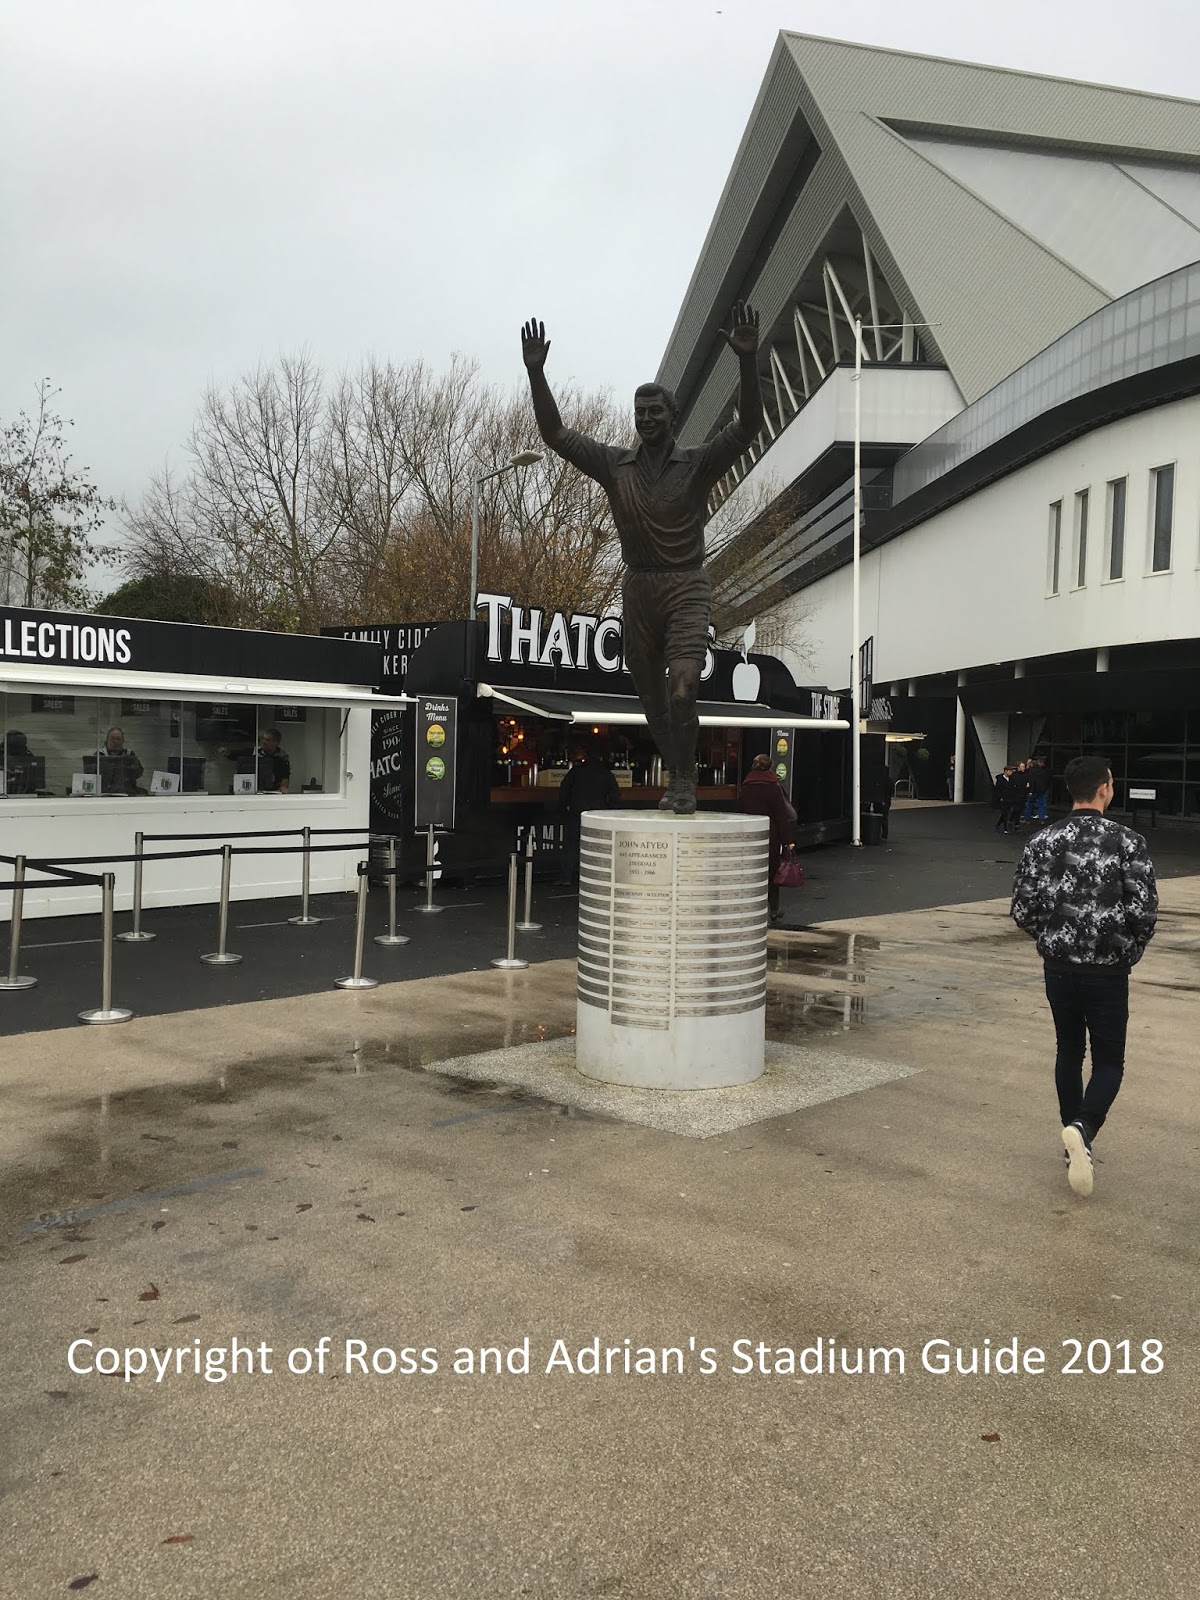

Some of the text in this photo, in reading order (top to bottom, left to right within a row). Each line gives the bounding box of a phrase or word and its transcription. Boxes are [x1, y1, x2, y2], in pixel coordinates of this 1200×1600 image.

[0, 619, 131, 664] LECTIONS
[398, 627, 437, 650] CID
[476, 593, 717, 681] THATC
[383, 655, 413, 675] KER
[43, 699, 63, 709] SALES
[132, 703, 151, 712] SALES
[424, 702, 450, 712] Drinks
[212, 707, 229, 716] SALES
[283, 709, 298, 718] SALES
[426, 712, 448, 722] Menu
[370, 751, 402, 780] HATC
[618, 840, 669, 850] JOHN ATYEO
